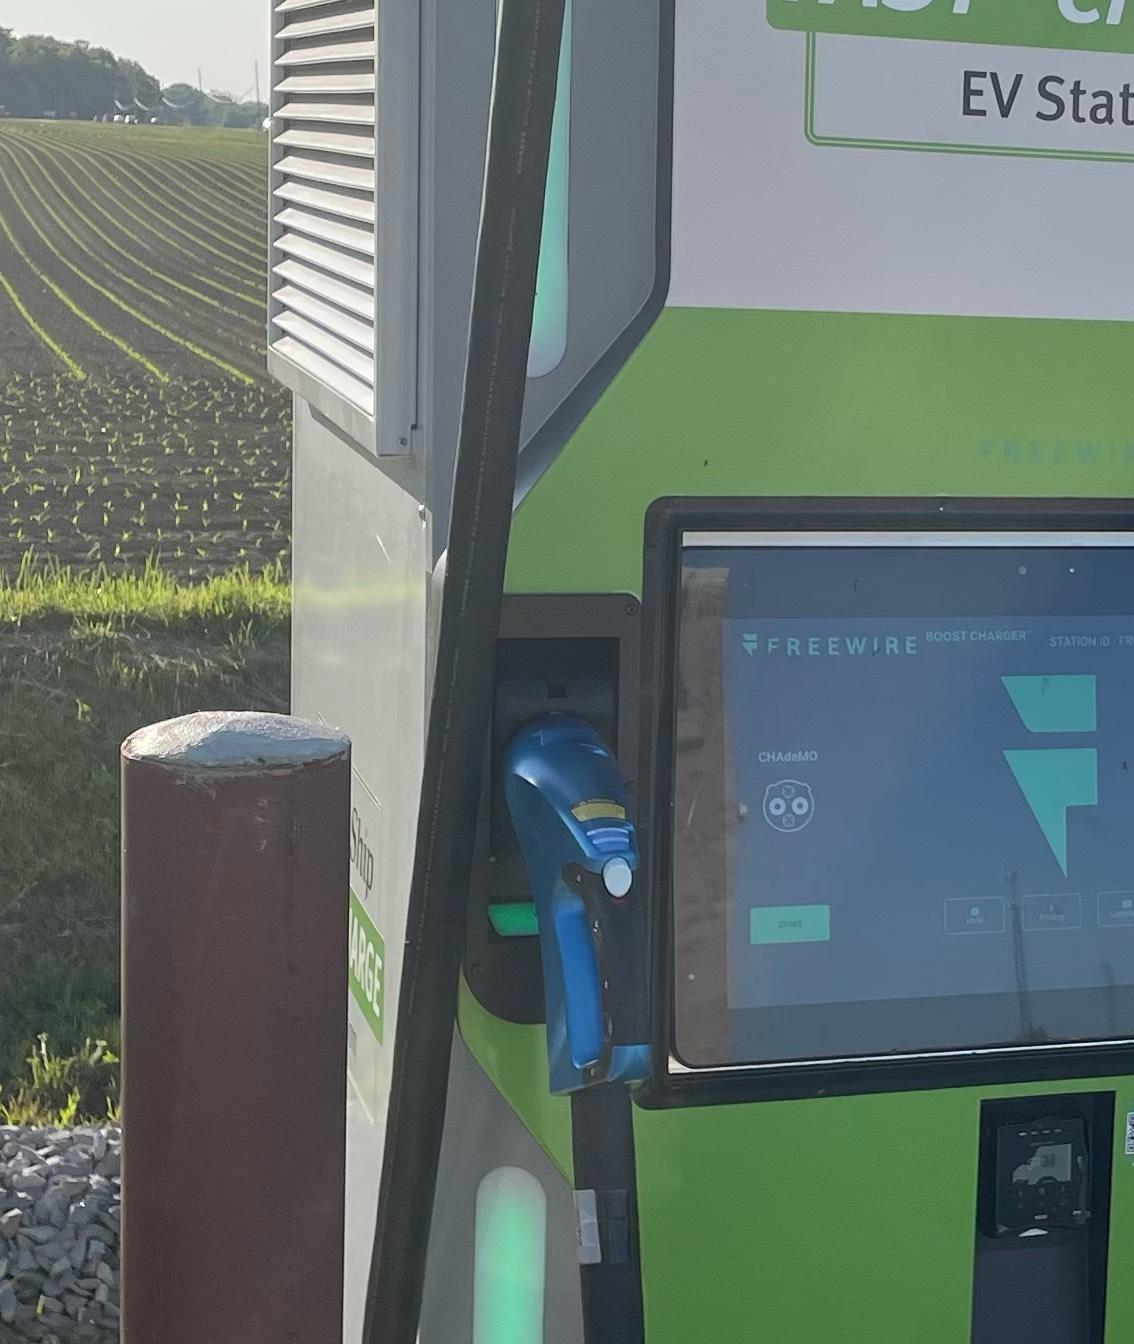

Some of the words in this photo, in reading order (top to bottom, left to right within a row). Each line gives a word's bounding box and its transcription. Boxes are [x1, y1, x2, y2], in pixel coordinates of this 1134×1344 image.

[961, 69, 1024, 119] EV
[925, 630, 966, 642] BOOST
[1050, 635, 1097, 648] STATION
[767, 636, 918, 655] FREEWIRE
[758, 750, 819, 763] CHAdeMO
